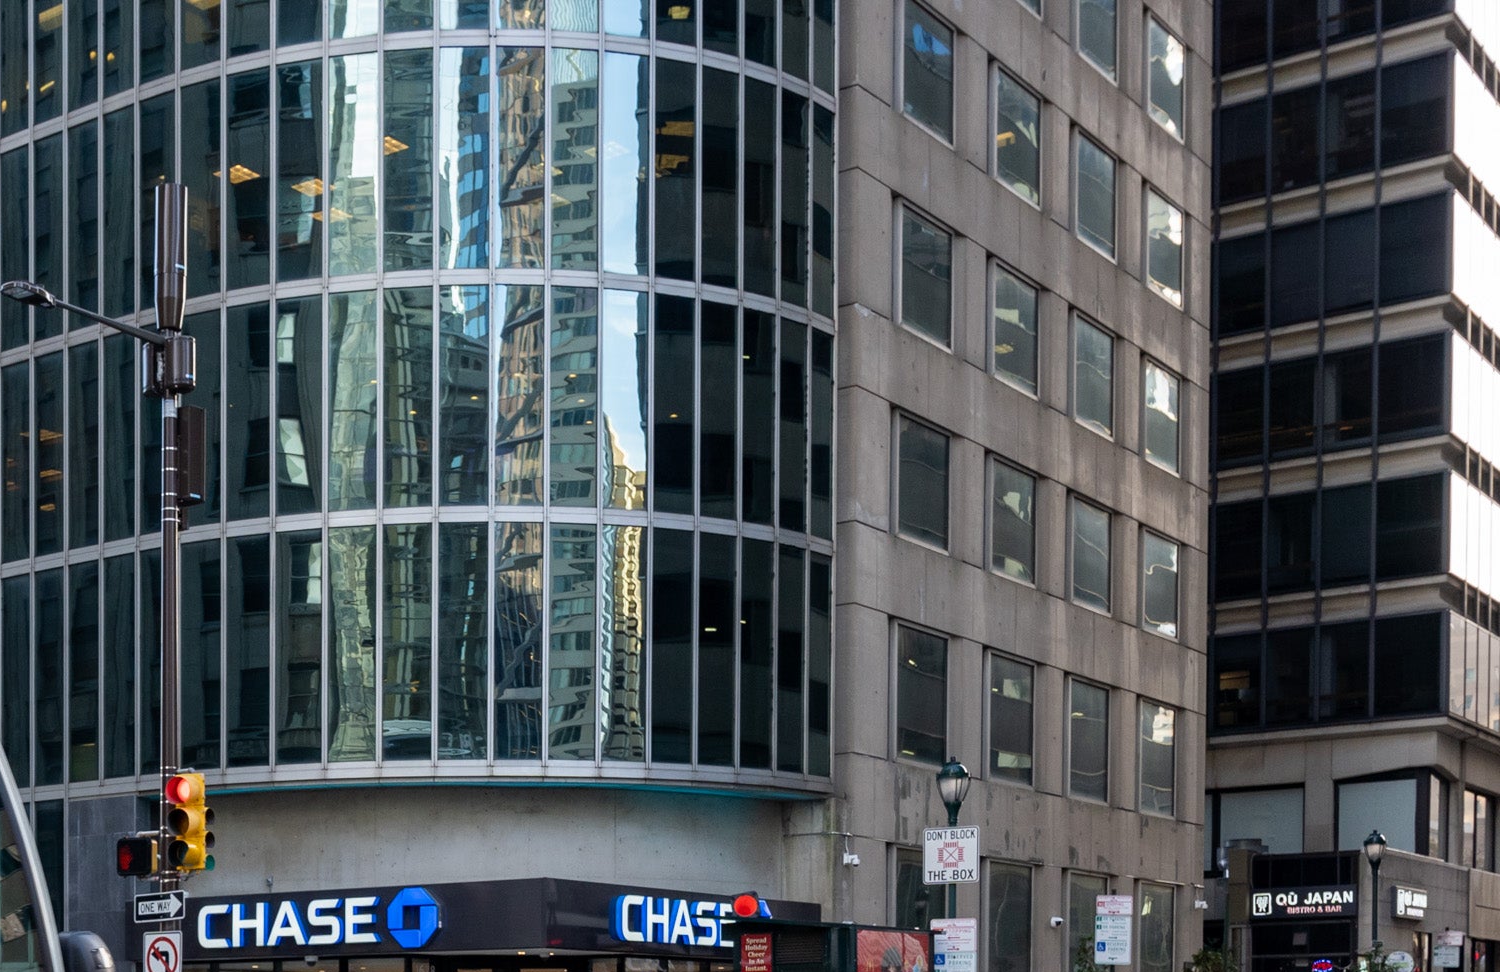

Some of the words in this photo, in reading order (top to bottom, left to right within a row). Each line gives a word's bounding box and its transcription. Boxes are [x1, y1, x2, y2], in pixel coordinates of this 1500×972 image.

[950, 829, 976, 840] BLOCK
[927, 870, 947, 881] THE
[952, 869, 974, 880] BOX
[1304, 890, 1354, 905] JAPAN
[140, 902, 155, 913] ONE
[157, 901, 171, 912] WAY
[1287, 906, 1316, 914] BISTRO
[1317, 905, 1323, 913] &
[1325, 905, 1342, 913] BAR
[197, 896, 382, 949] CHASE
[610, 894, 735, 948] CHASE
[746, 937, 767, 945] Spread
